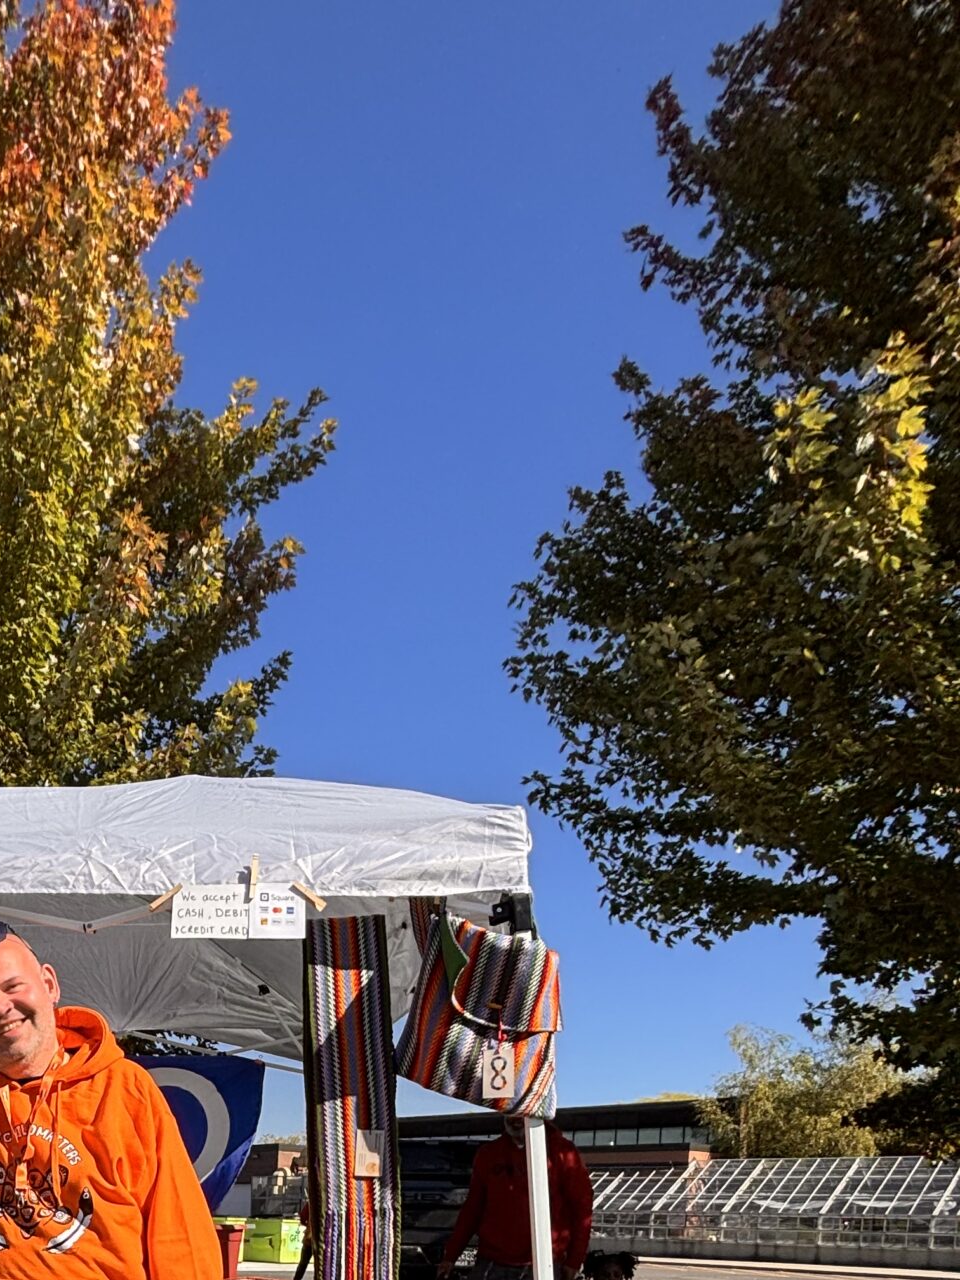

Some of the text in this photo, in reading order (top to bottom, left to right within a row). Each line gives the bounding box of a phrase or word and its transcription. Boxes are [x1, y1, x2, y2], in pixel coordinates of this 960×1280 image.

[181, 891, 239, 904] We accept
[270, 893, 296, 902] Square
[215, 907, 249, 918] DEBIT
[220, 926, 248, 936] CARD
